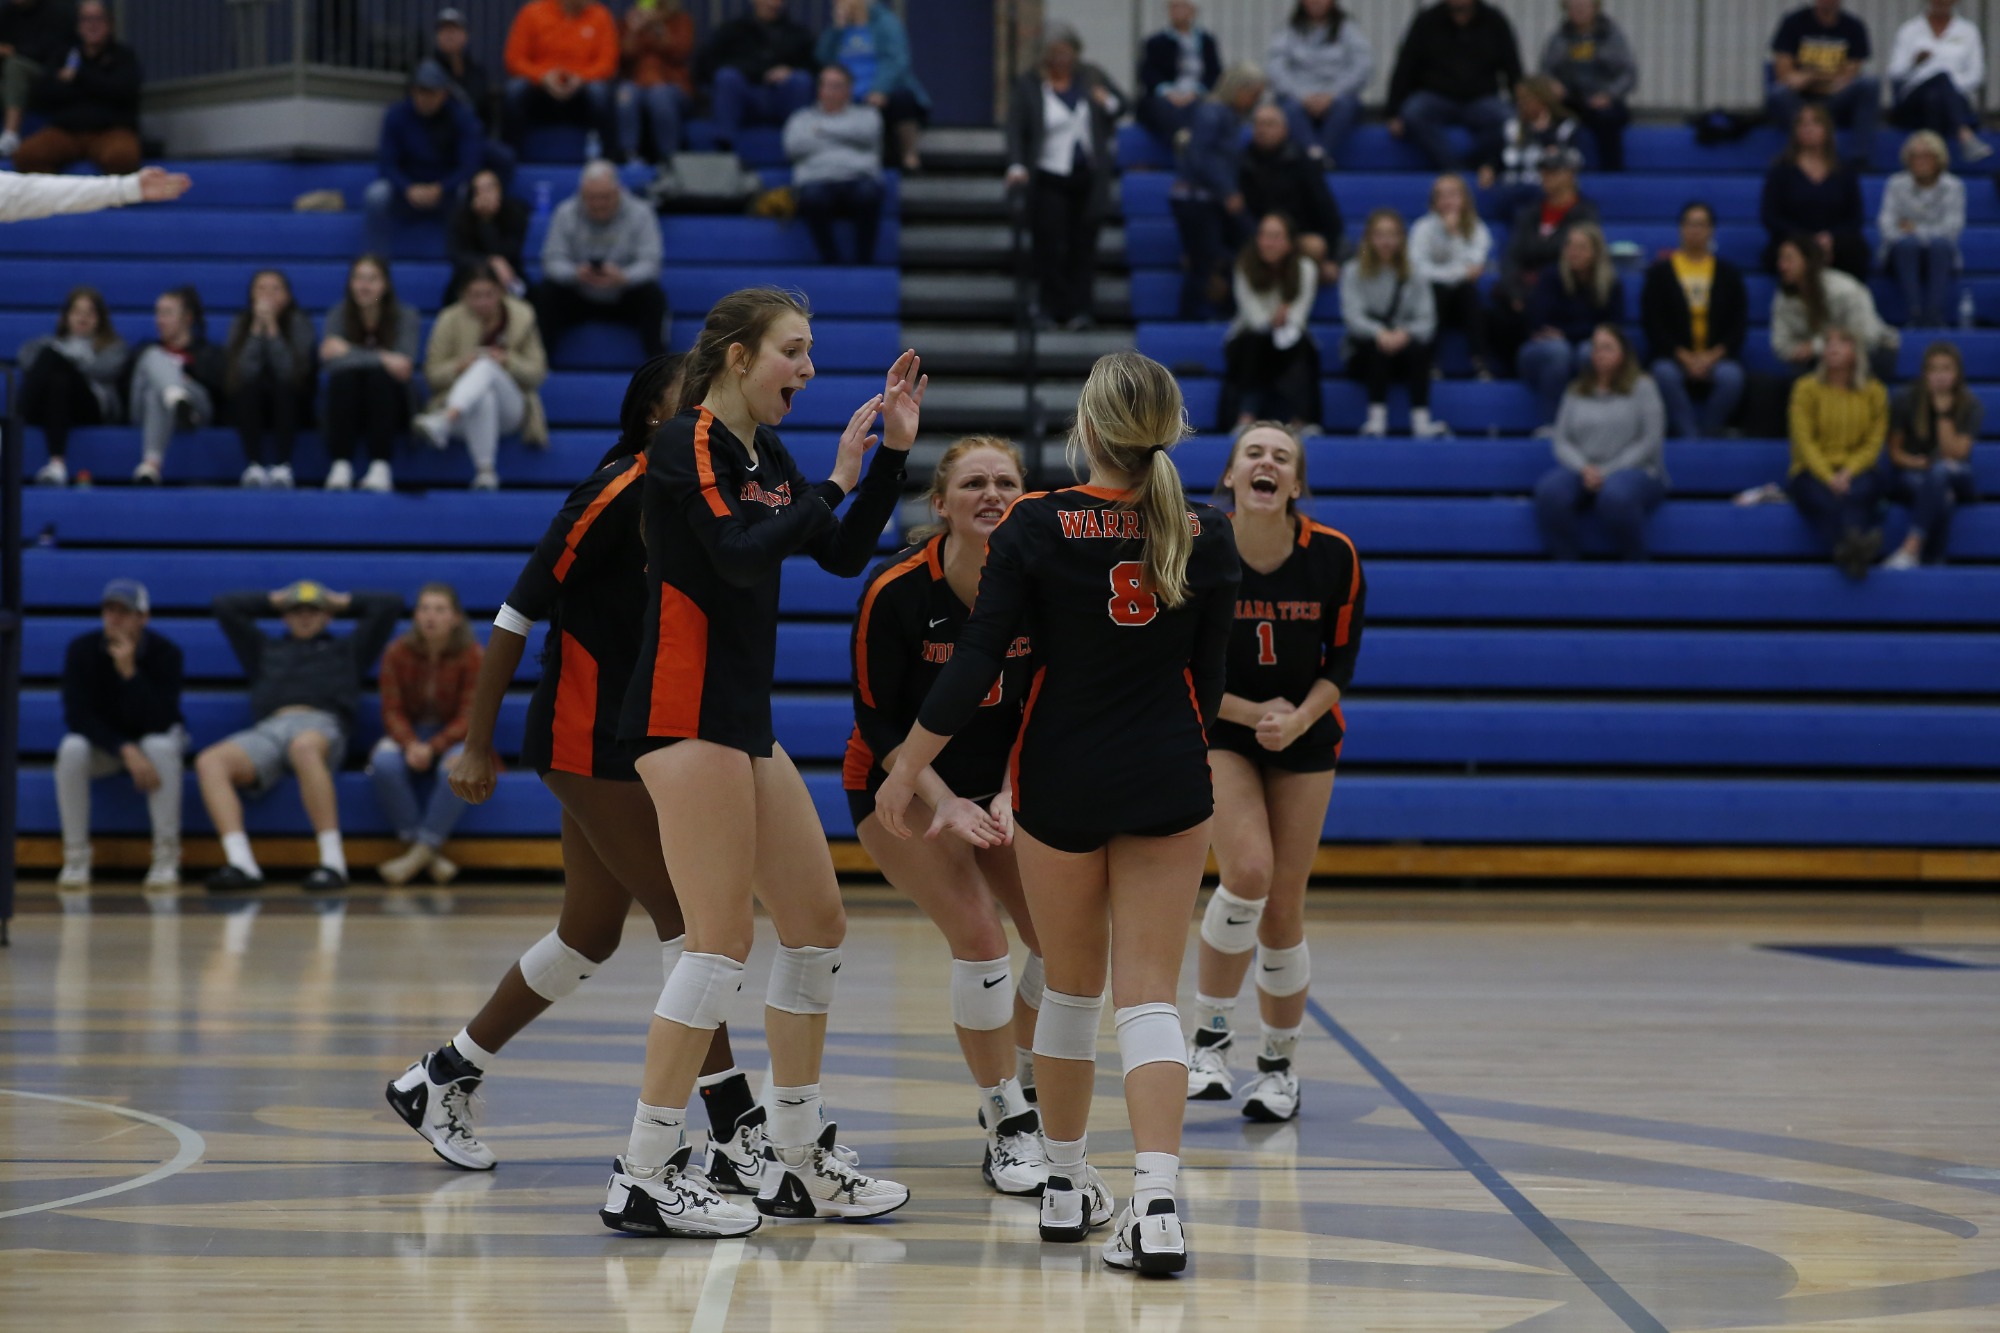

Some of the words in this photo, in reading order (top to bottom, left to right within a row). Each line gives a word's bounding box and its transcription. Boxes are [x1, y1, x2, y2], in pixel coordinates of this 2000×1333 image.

[1058, 509, 1201, 539] WARRS
[1108, 560, 1160, 627] 8
[1277, 601, 1322, 620] TECH
[1256, 621, 1278, 666] 1
